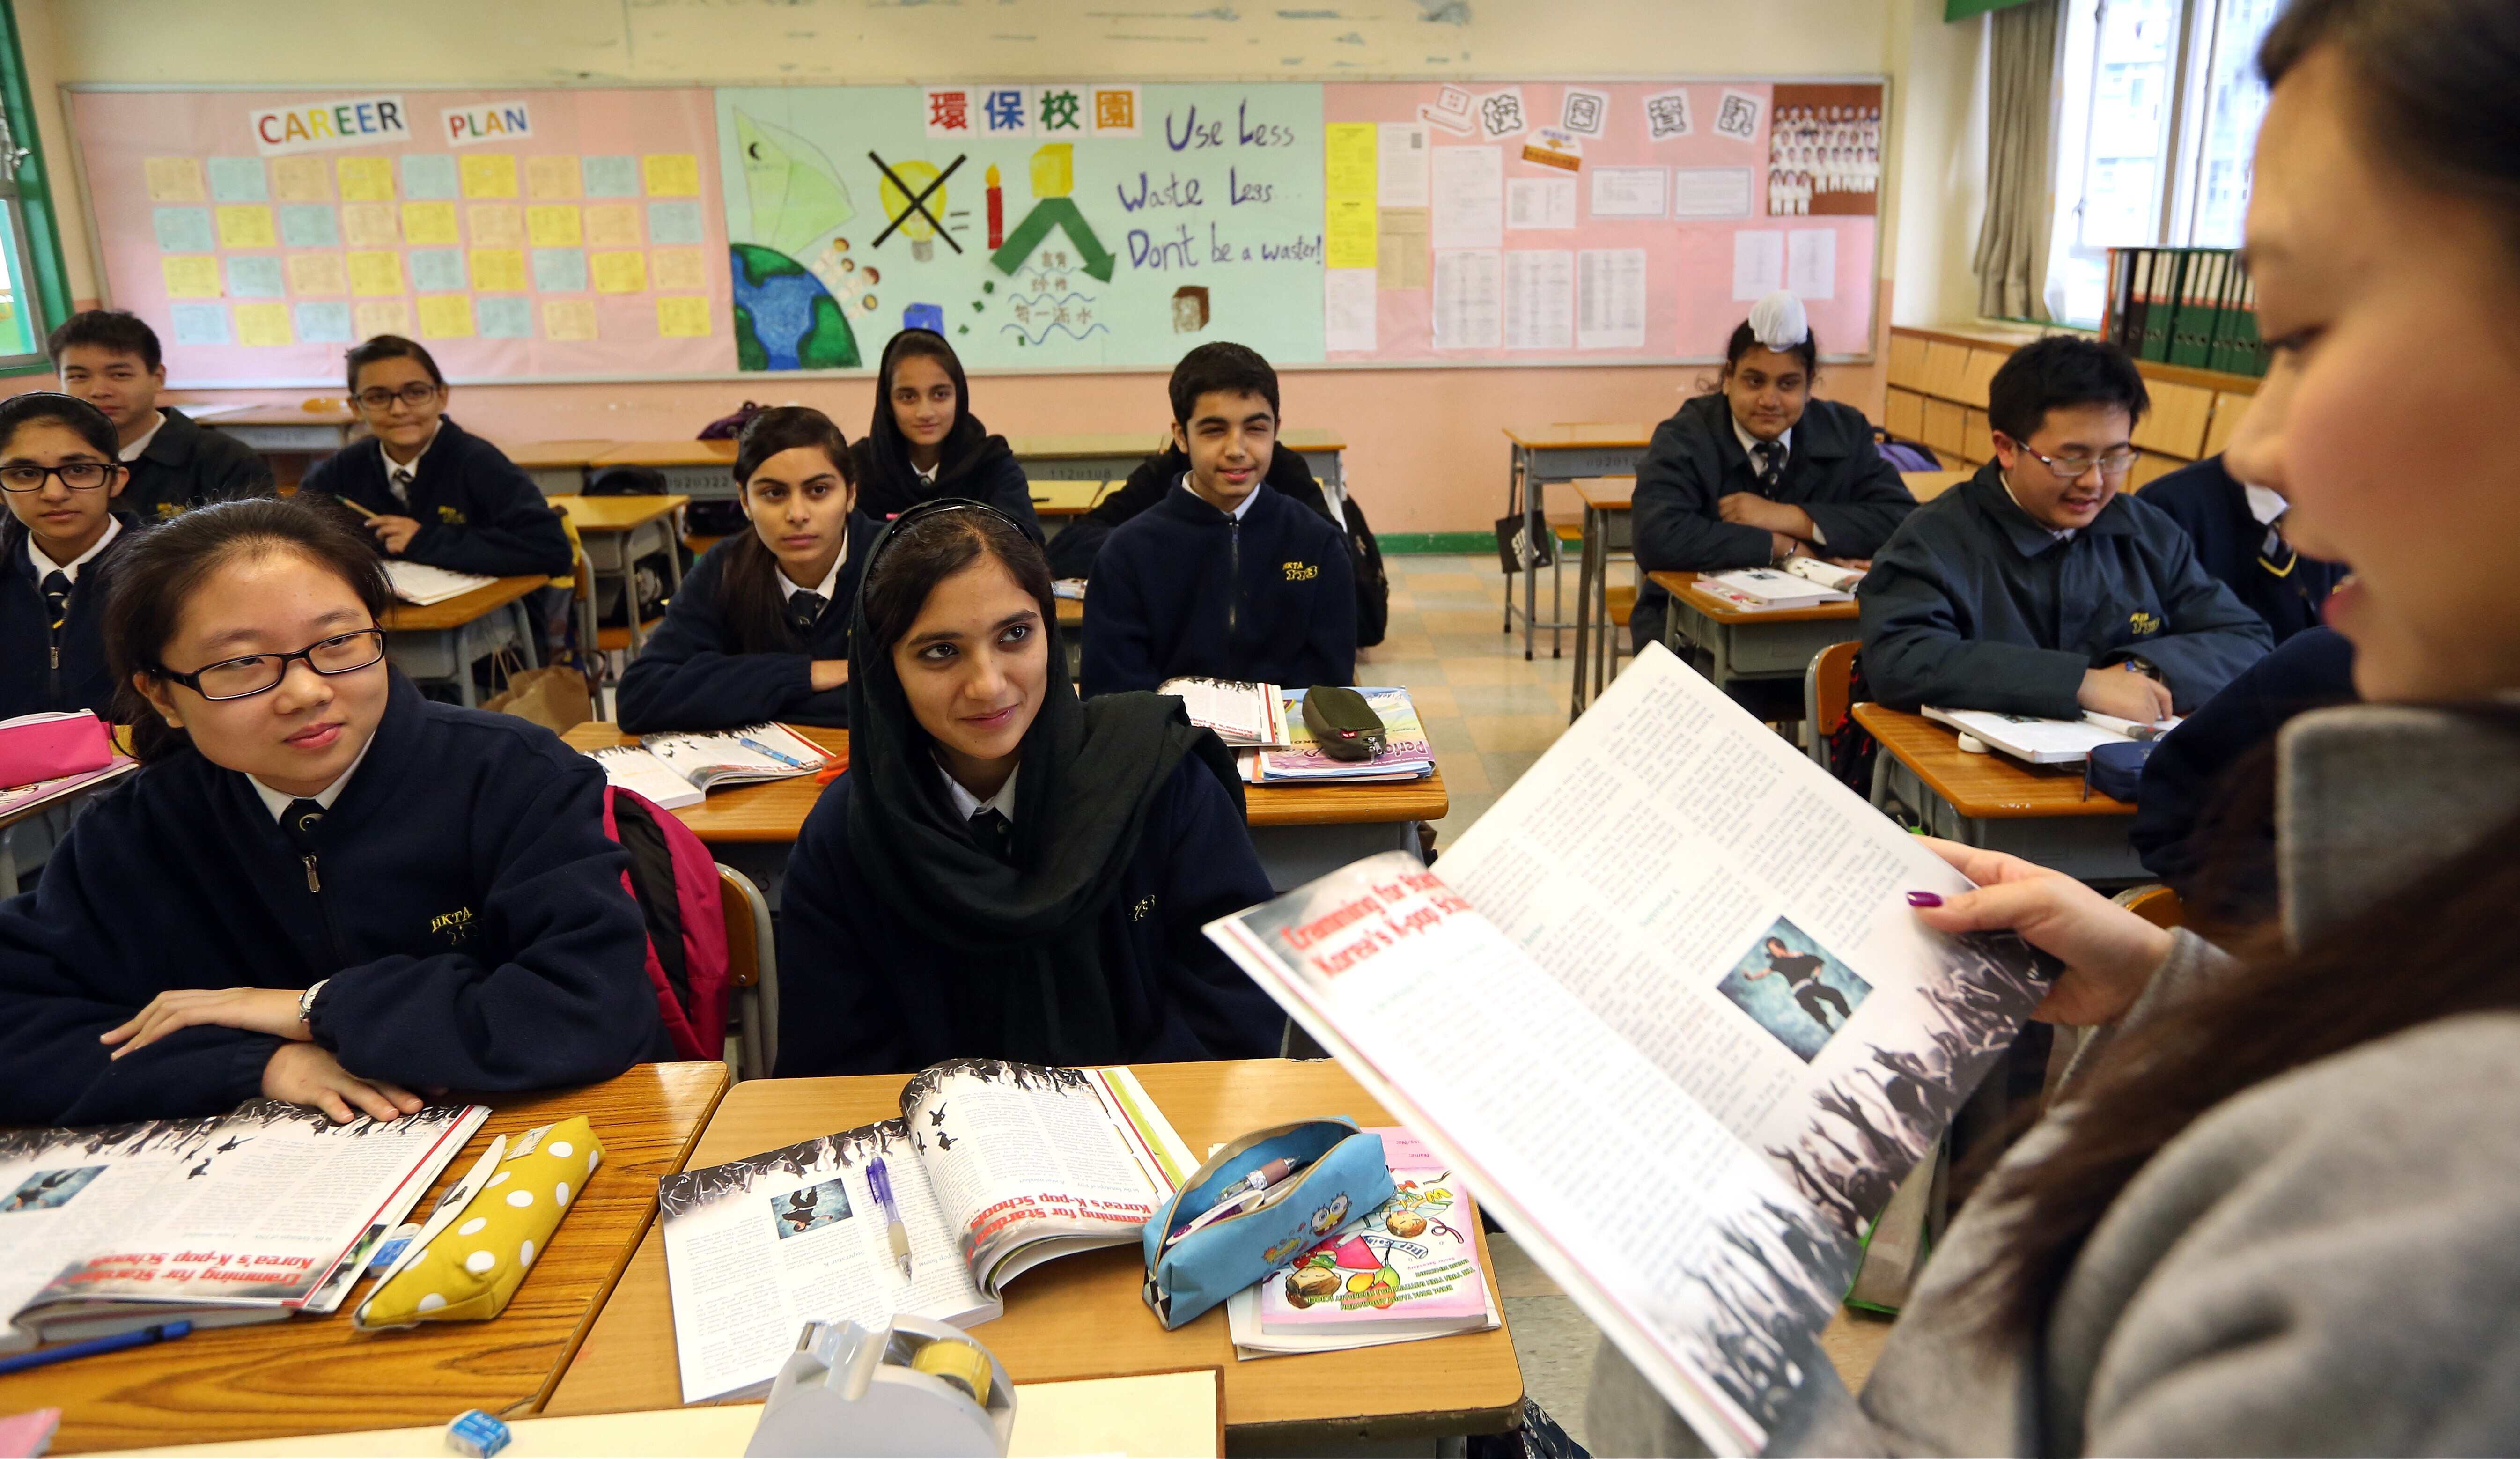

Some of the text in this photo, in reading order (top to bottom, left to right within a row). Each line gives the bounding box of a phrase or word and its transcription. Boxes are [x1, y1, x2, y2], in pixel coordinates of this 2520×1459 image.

[928, 90, 1134, 133] 環保校園
[258, 102, 527, 144] CAREER PLAN
[1165, 98, 1296, 152] Use Less
[1117, 171, 1204, 213] Waste
[1127, 221, 1199, 270] Don't
[1210, 221, 1232, 263] be
[1242, 249, 1253, 262] a
[1385, 741, 1429, 757] Perfo
[1039, 1193, 1087, 1208] K-pop
[1091, 1200, 1152, 1215] Korea's
[1051, 1208, 1077, 1219] for
[1079, 1208, 1153, 1225] ramming
[238, 1254, 316, 1269] Korea's
